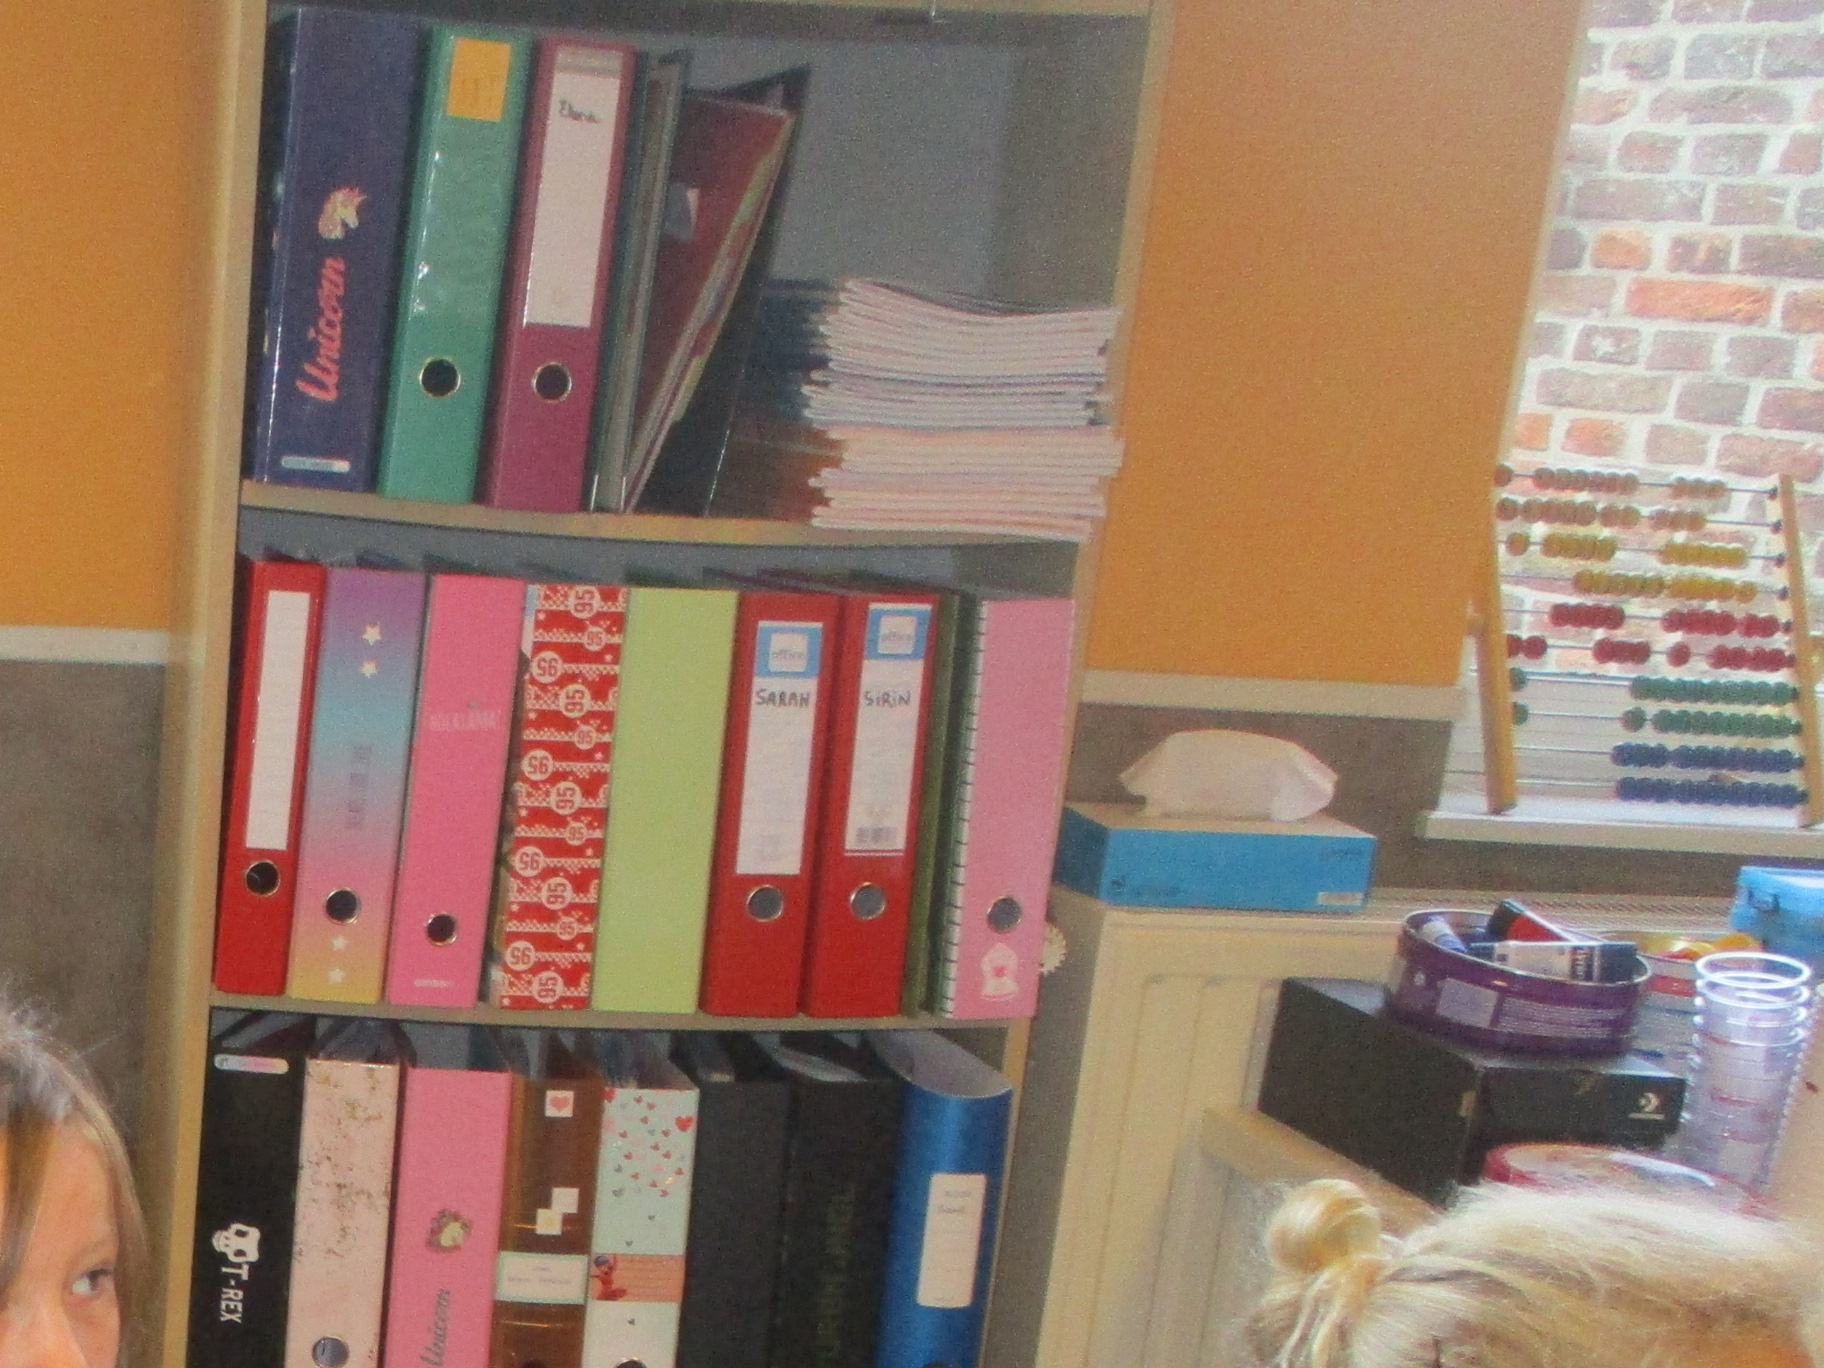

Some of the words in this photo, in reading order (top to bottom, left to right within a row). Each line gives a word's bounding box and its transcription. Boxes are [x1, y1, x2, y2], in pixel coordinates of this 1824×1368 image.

[295, 255, 347, 402] Unicorn
[755, 688, 810, 708] SARAH
[219, 1263, 250, 1325] T-REX
